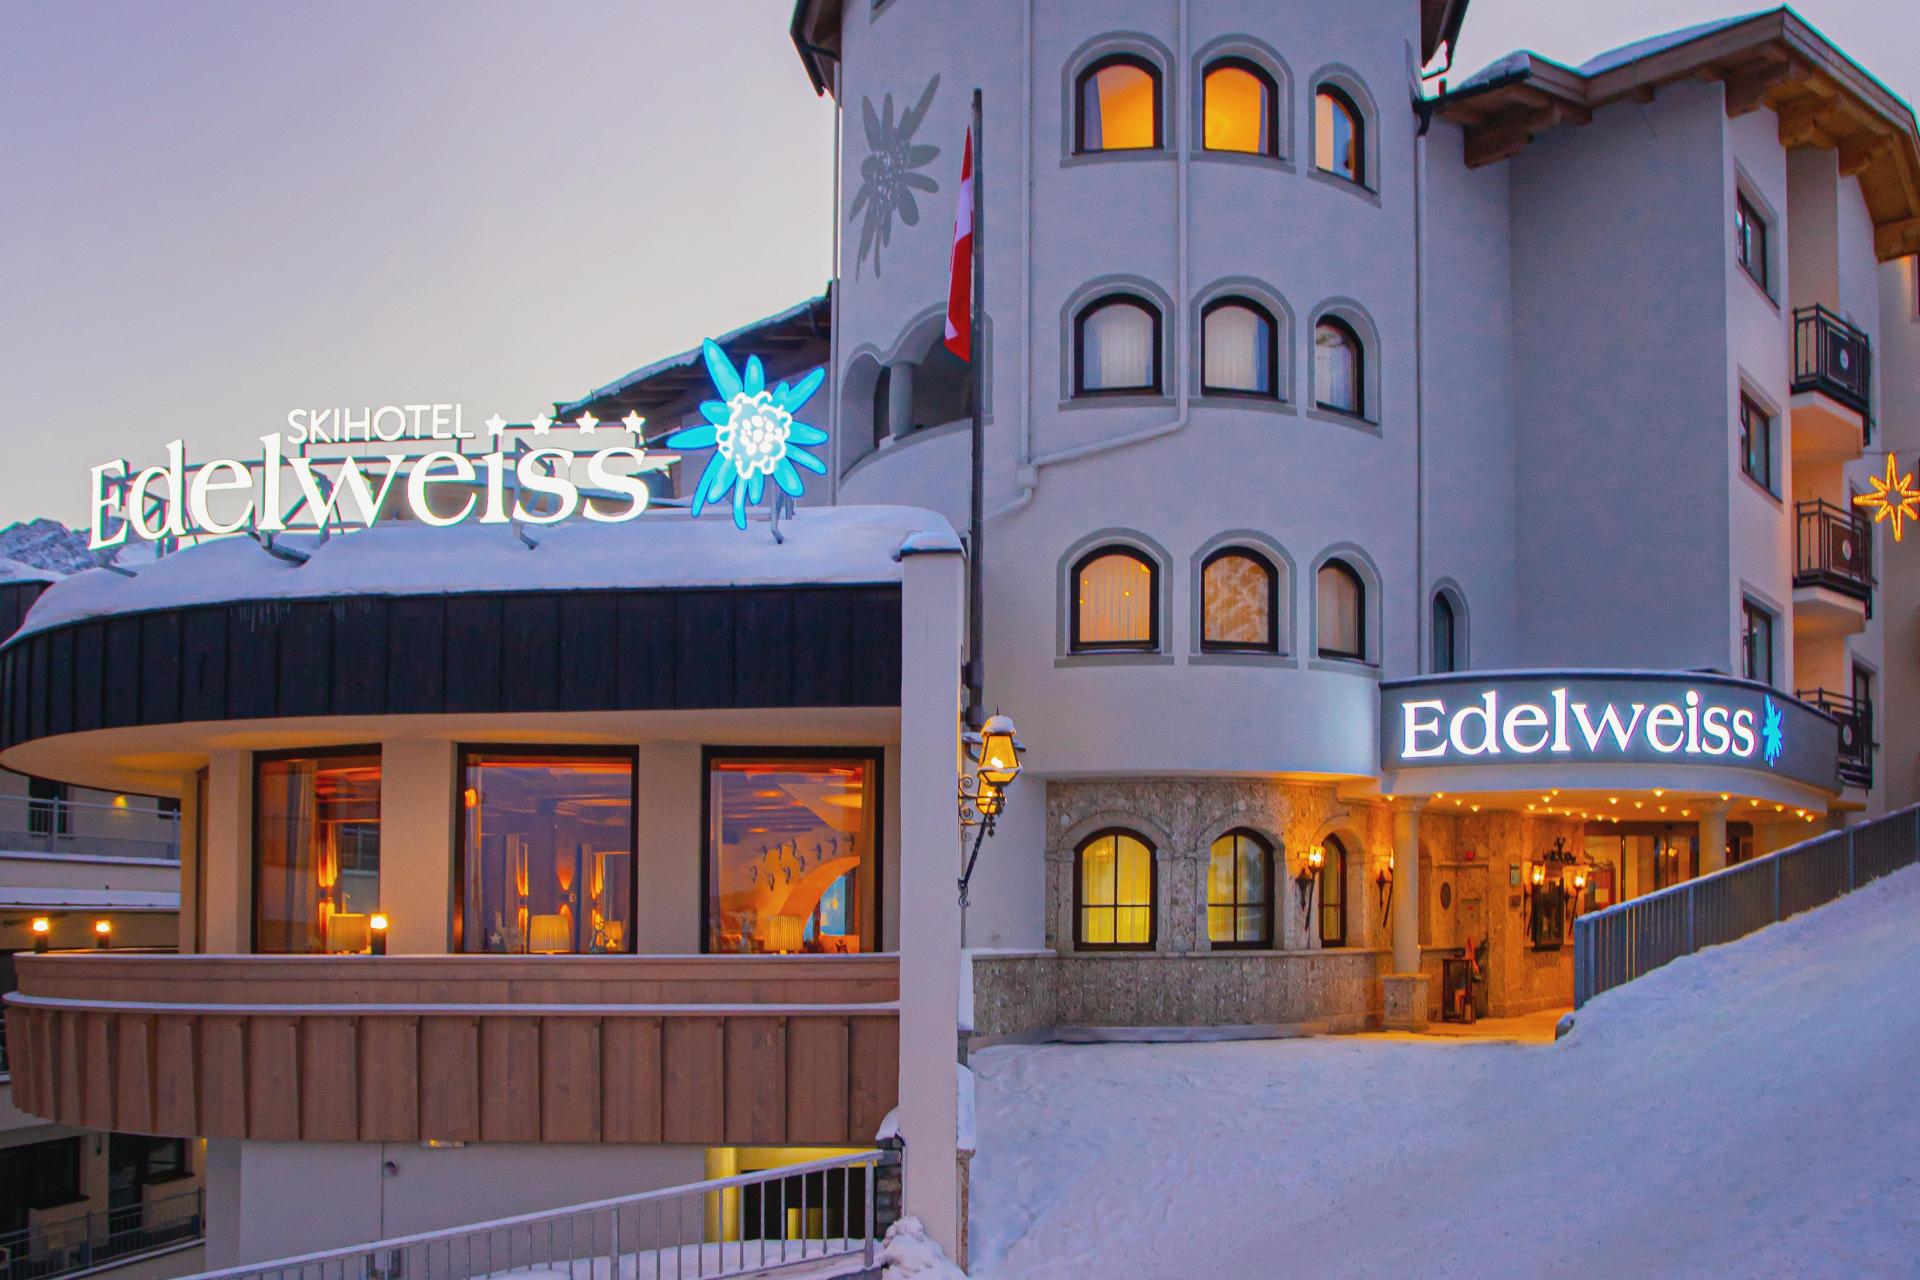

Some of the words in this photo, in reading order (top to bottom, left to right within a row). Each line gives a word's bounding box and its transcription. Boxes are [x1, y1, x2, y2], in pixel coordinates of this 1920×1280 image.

[286, 403, 475, 444] SKIHOTEL
[87, 432, 650, 551] Edelweiss
[1401, 687, 1756, 758] Edelweiss
